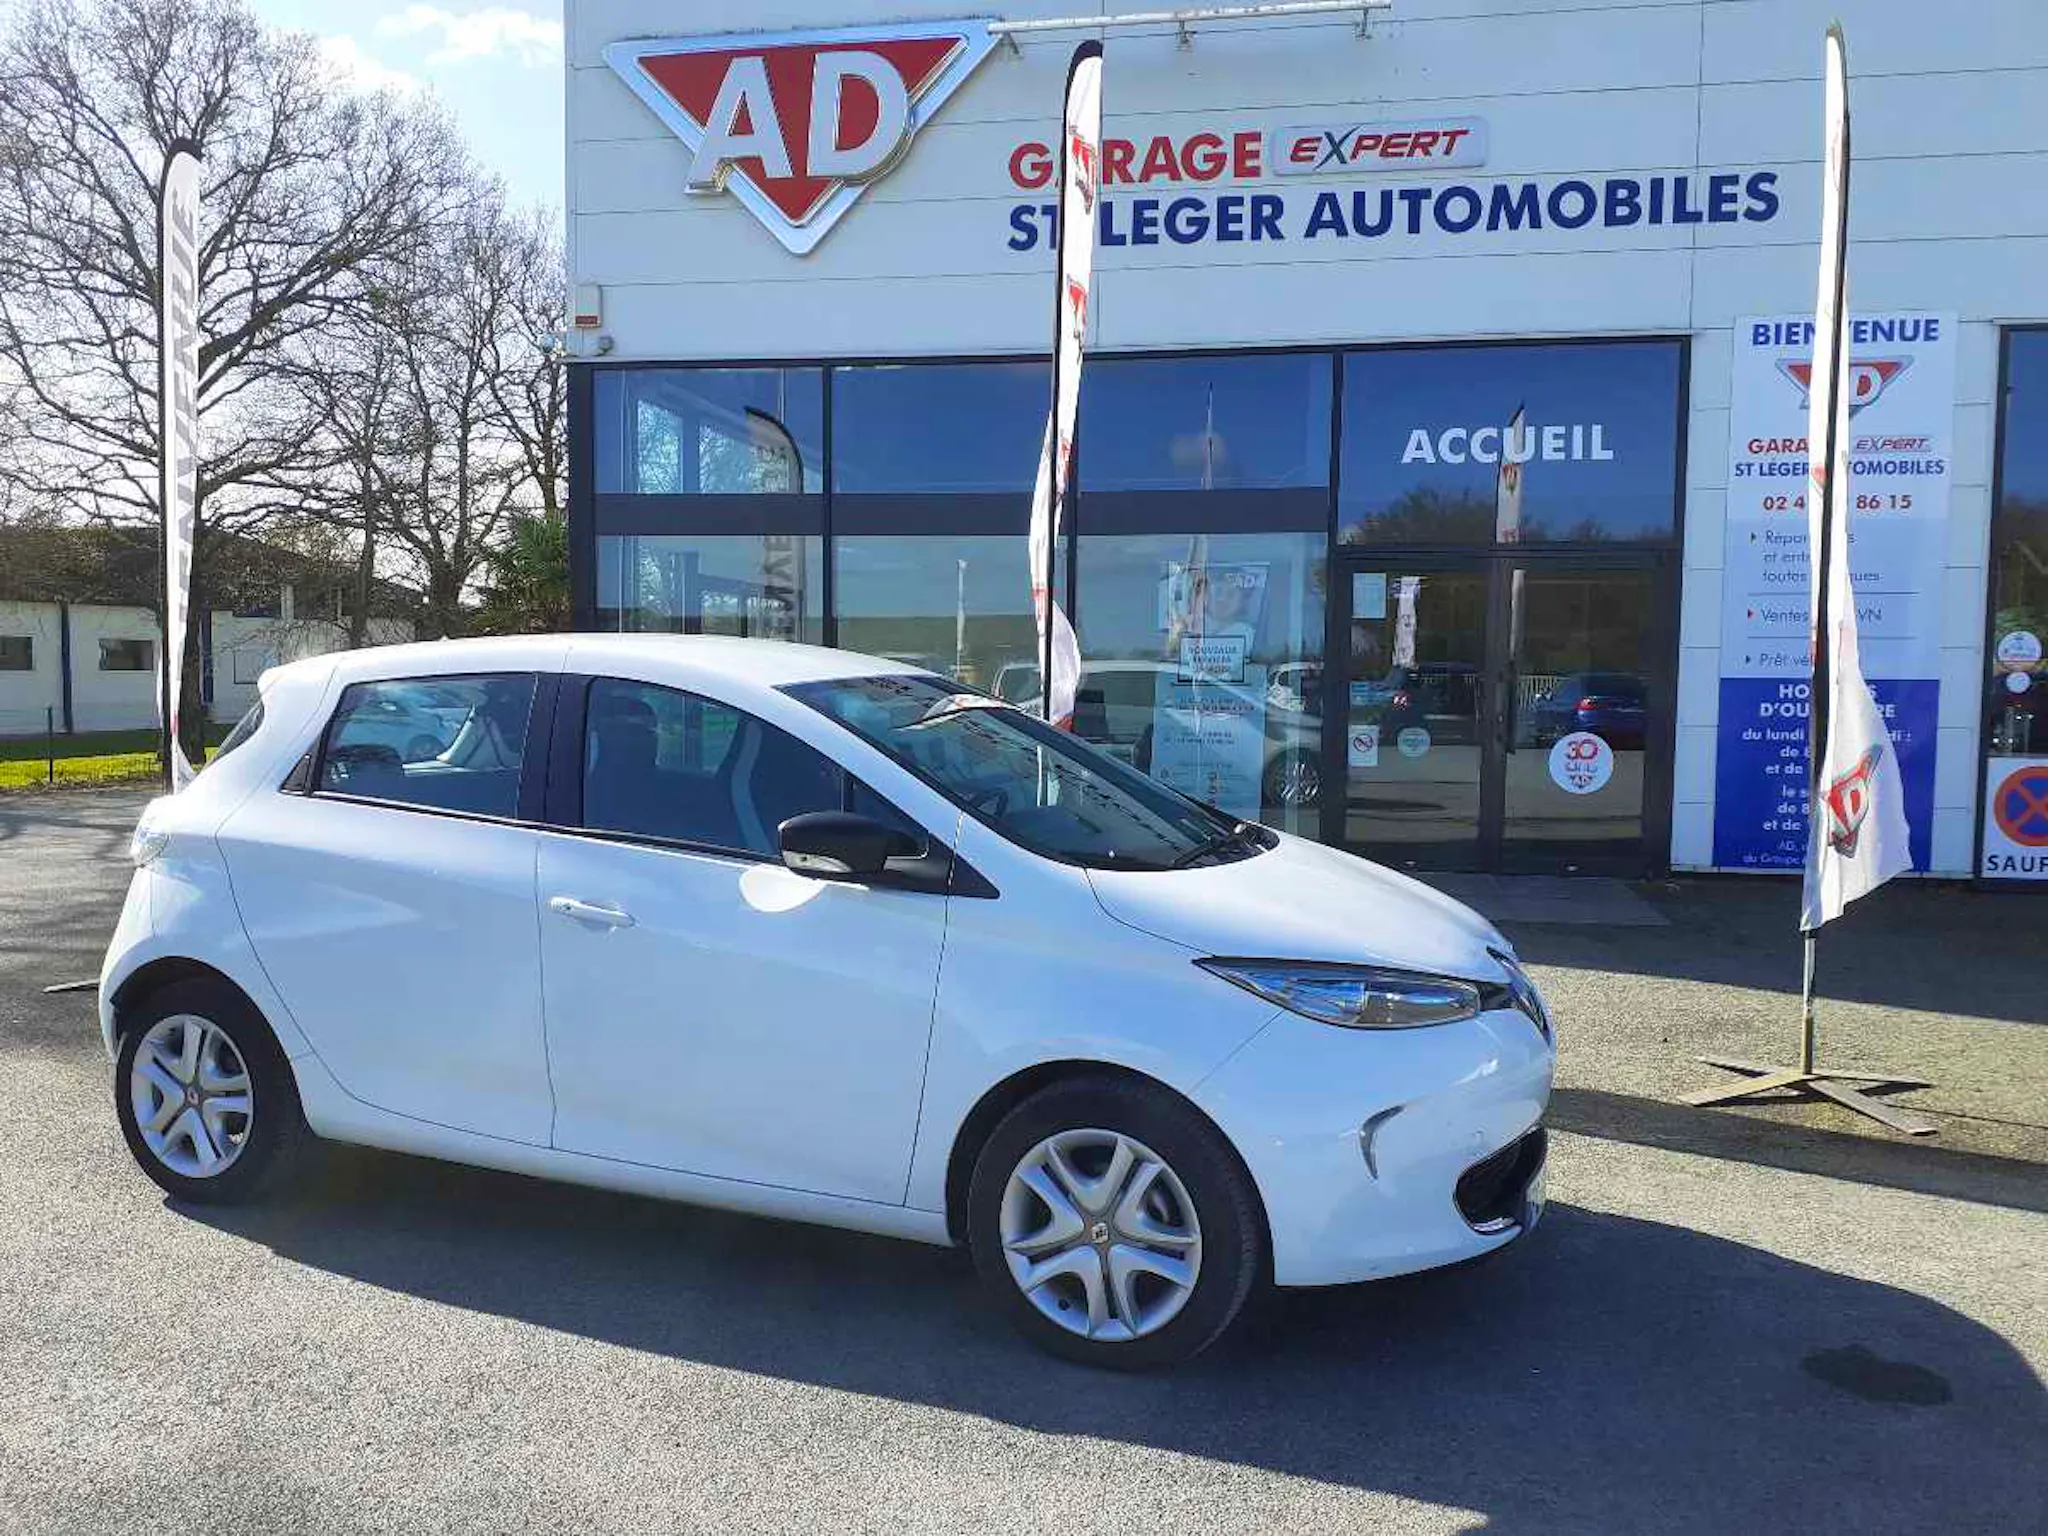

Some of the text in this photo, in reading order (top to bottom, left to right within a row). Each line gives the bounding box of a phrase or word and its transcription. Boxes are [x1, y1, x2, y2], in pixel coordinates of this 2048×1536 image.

[683, 49, 913, 194] AD
[1008, 131, 1262, 190] GRAGE
[1289, 125, 1470, 172] EXPERT
[1100, 194, 1286, 247] LEGER
[1303, 171, 1780, 239] AUTOMOBILES
[1752, 318, 1940, 346] BIENENUE
[1401, 424, 1614, 465] ACCUEIL
[1748, 438, 1809, 454] GARA
[1735, 462, 1756, 477] ST
[1763, 496, 1789, 511] 02
[1857, 494, 1881, 510] 86
[1889, 493, 1912, 509] 15
[1761, 608, 1809, 622] Ventes
[1742, 729, 1805, 741] du lundi
[1780, 747, 1799, 758] de
[1765, 764, 1803, 775] et de
[1777, 802, 1797, 814] de
[1762, 819, 1802, 831] et de
[1986, 854, 2048, 873] SAUF
